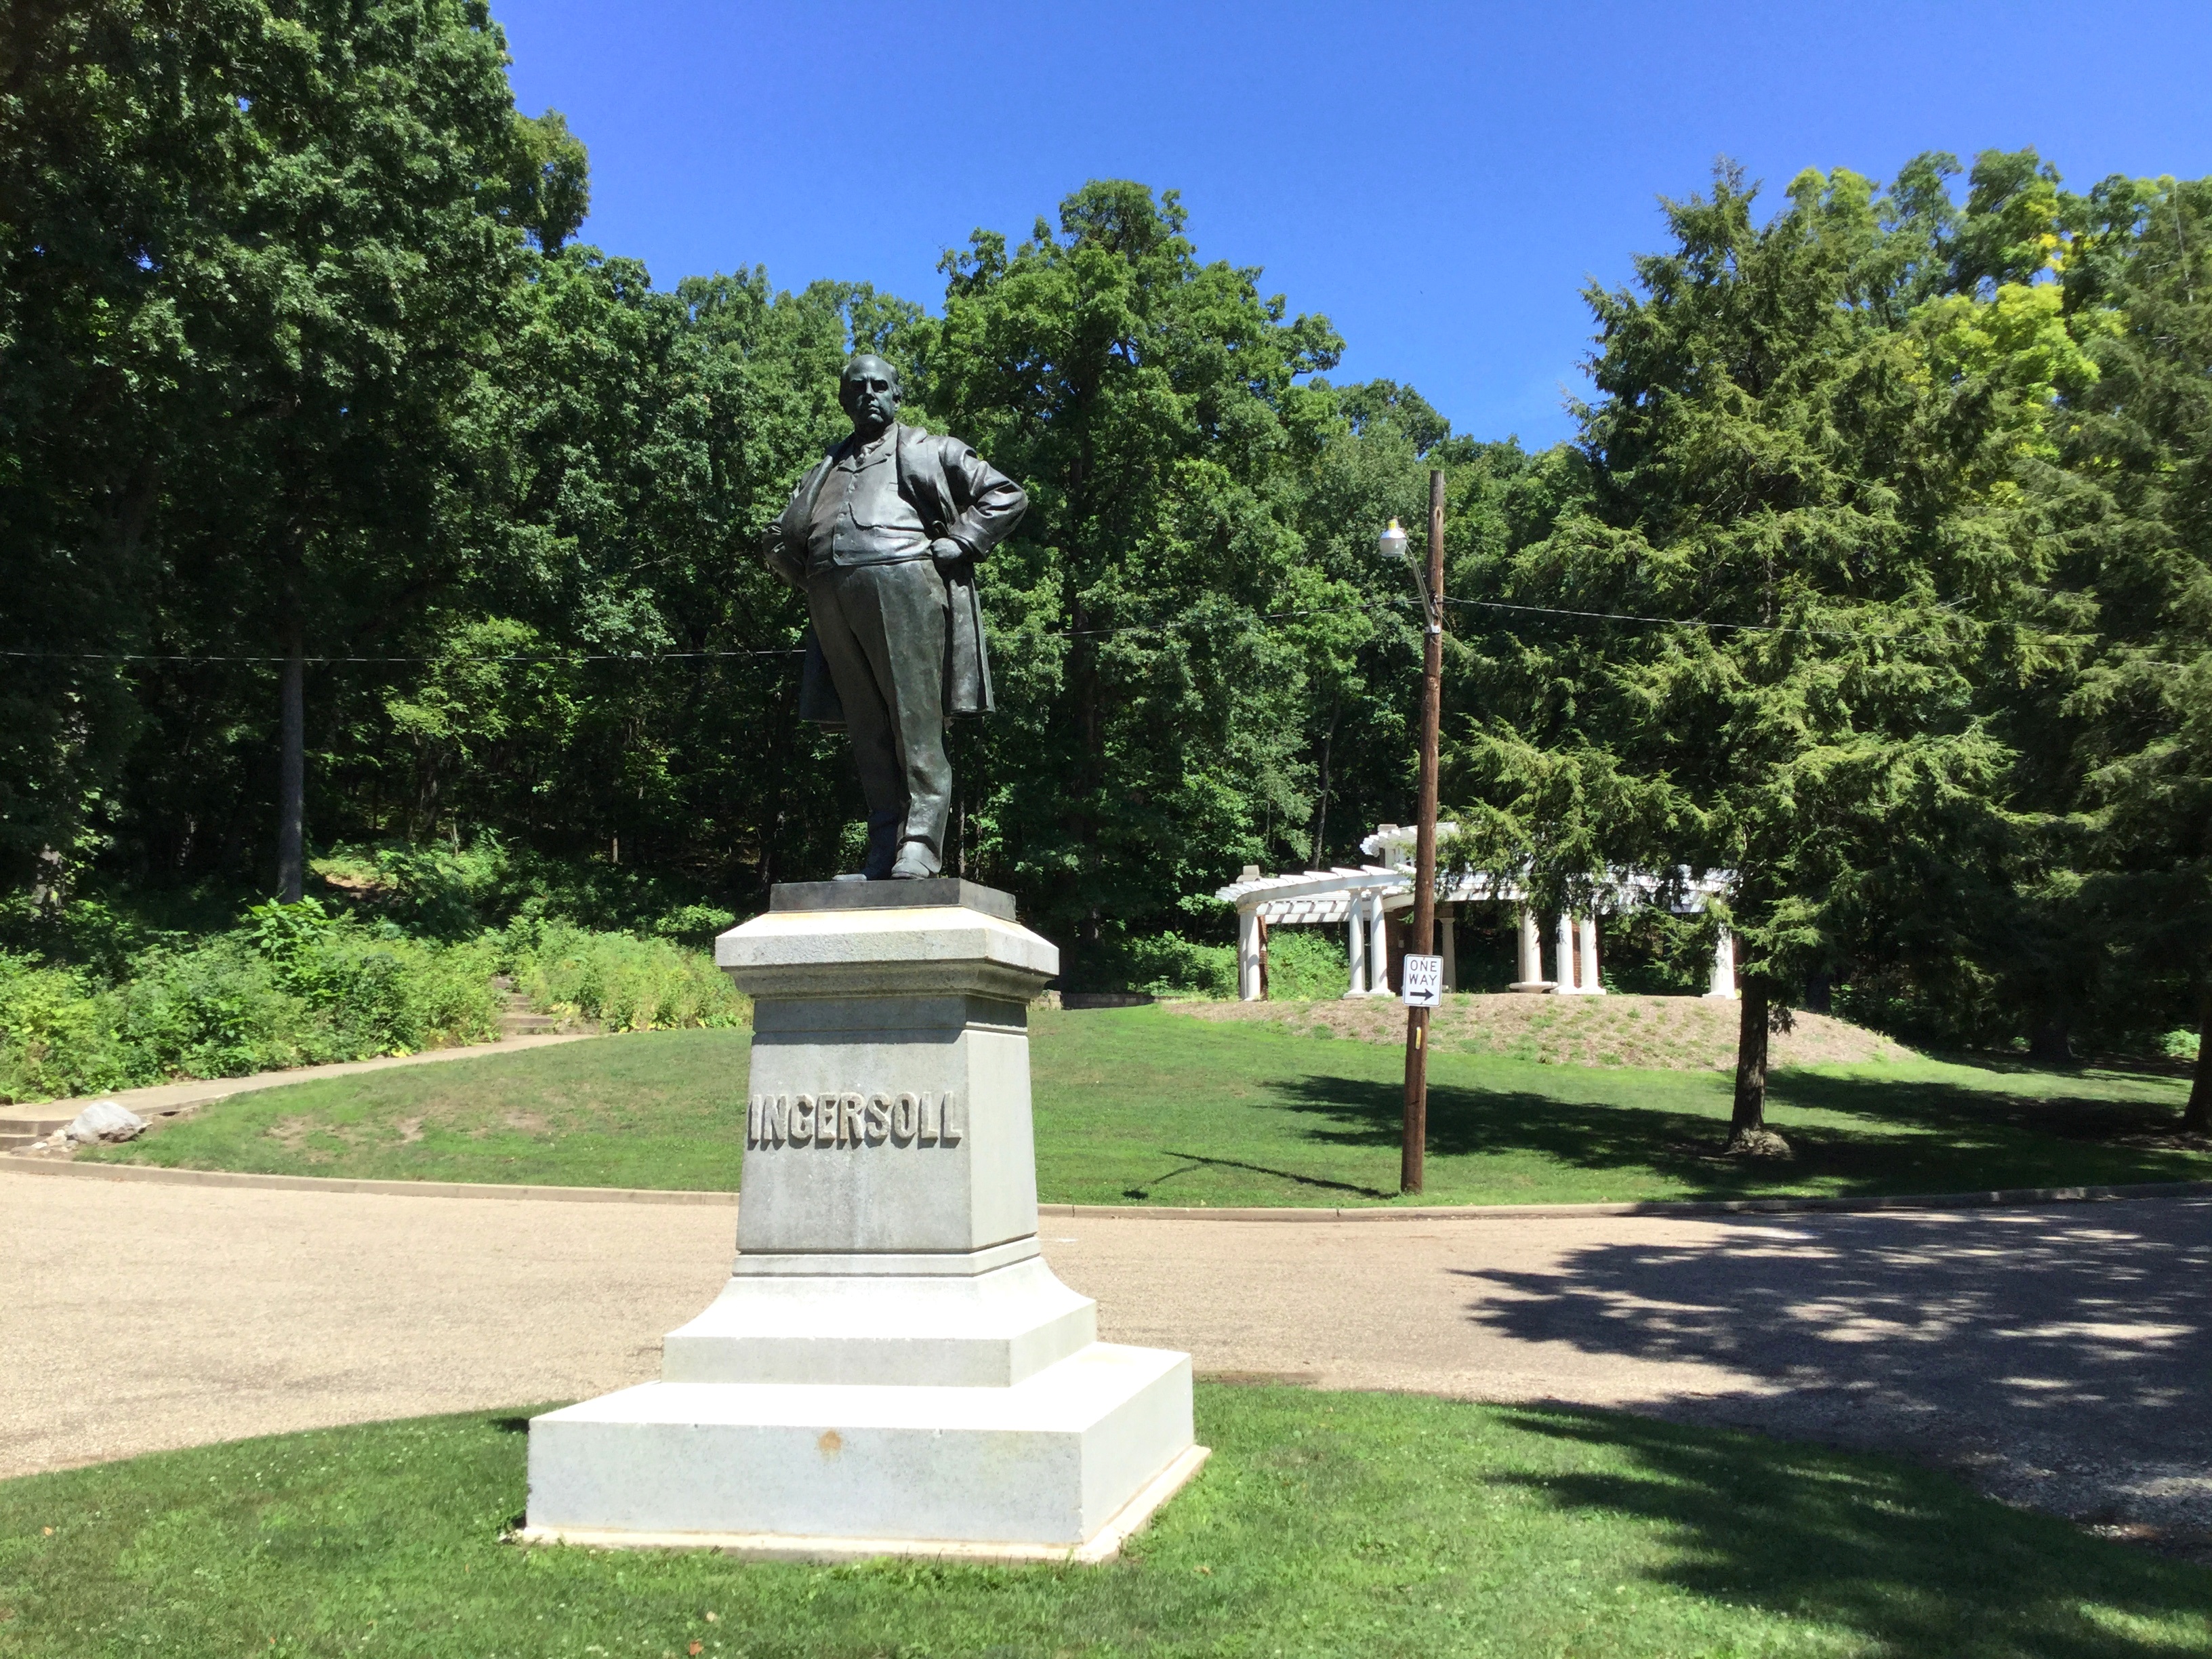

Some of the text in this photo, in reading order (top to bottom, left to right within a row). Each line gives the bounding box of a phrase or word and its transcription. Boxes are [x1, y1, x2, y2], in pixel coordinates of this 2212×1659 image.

[1410, 960, 1437, 972] ONE
[1410, 974, 1437, 985] WAY
[749, 1091, 963, 1144] INGERSOLL
